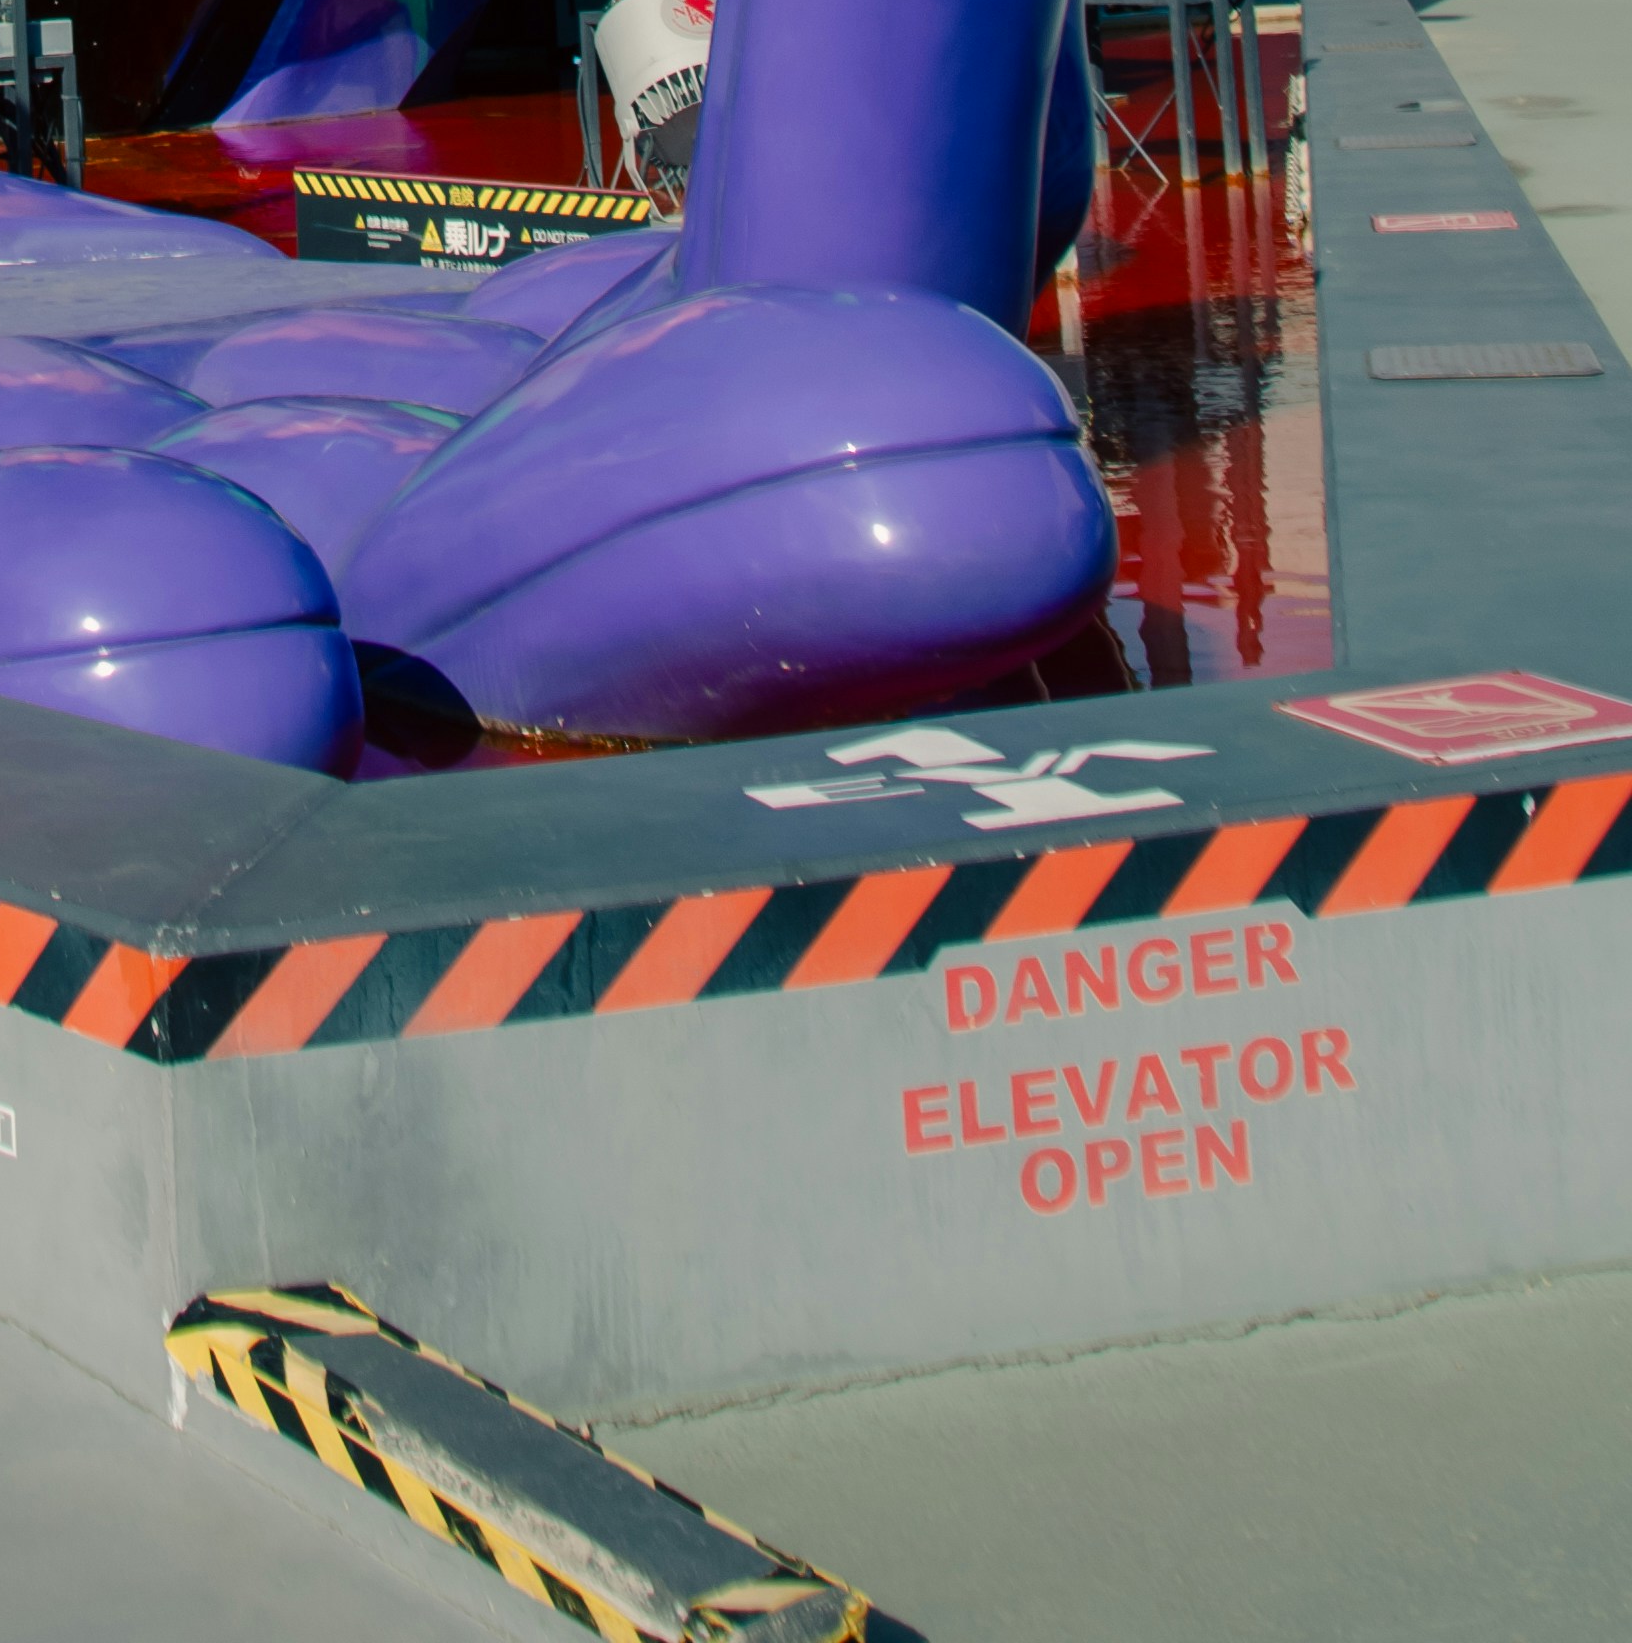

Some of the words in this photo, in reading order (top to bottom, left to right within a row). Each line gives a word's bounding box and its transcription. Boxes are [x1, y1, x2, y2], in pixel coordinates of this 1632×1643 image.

[444, 217, 511, 259] 乗ルナ
[944, 922, 1299, 1032] DANGER
[902, 1026, 1356, 1154] ELEVATOR
[1020, 1119, 1251, 1215] OPEN
